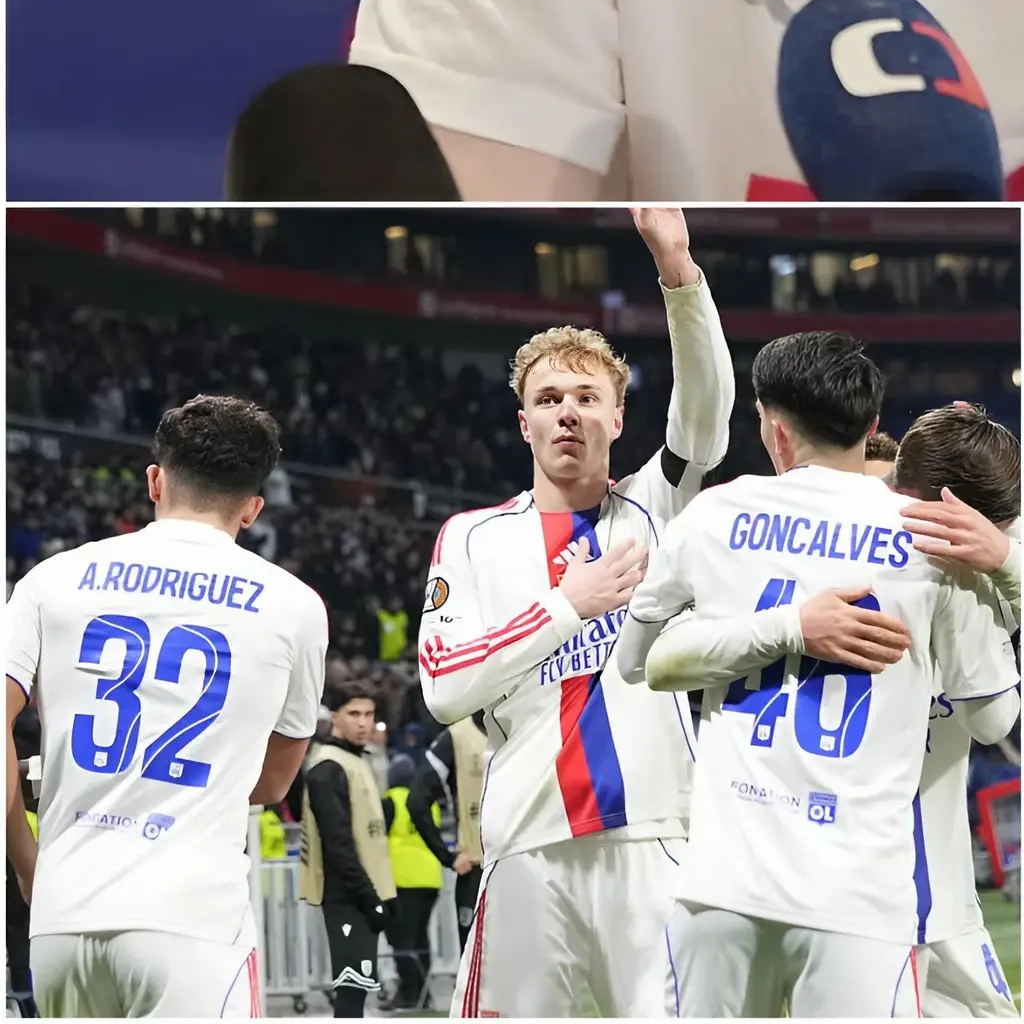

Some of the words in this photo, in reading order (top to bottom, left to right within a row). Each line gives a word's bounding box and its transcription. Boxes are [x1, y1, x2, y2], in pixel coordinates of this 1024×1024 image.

[729, 513, 913, 568] GONCALVES
[78, 562, 265, 613] A.RODRIGUEZ
[571, 642, 611, 672] BETT
[71, 613, 232, 788] 32
[809, 805, 834, 822] OL
